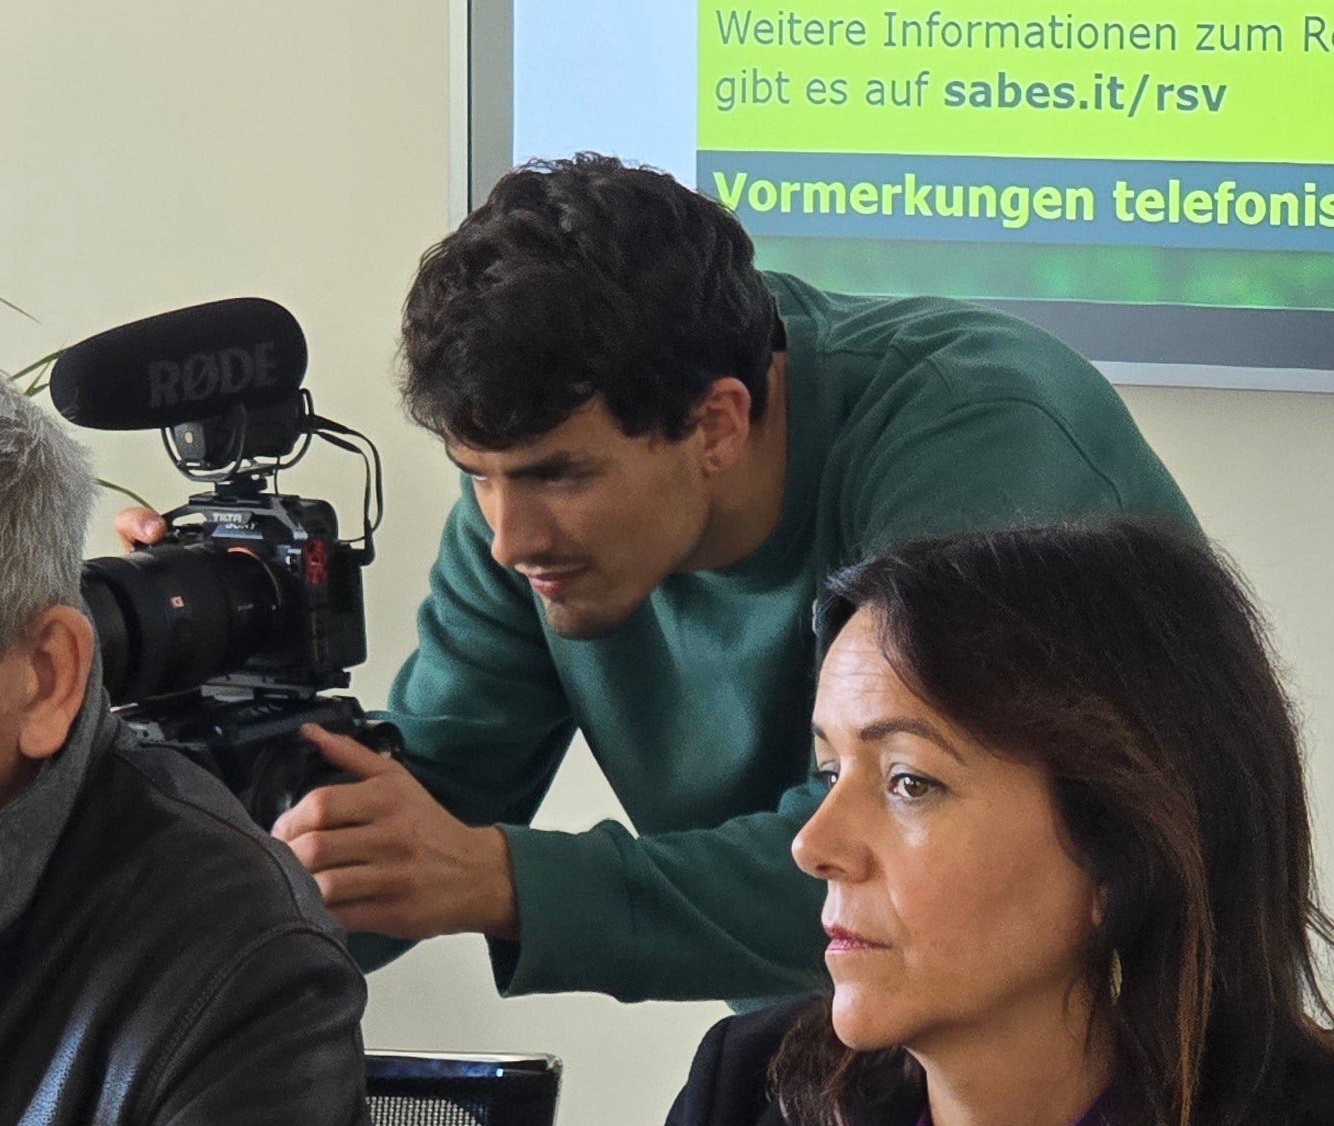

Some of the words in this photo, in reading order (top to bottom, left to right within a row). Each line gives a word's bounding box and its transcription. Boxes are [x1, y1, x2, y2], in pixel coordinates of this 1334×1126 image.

[717, 9, 867, 50] Weitere
[882, 9, 1179, 54] Informationen
[1195, 21, 1284, 54] zum
[714, 69, 791, 110] gibt
[804, 79, 850, 108] es
[865, 70, 932, 109] auf
[943, 72, 1228, 118] sabes.it/rsv
[714, 172, 1096, 229] Vormerkungen
[146, 340, 279, 409] RØDE
